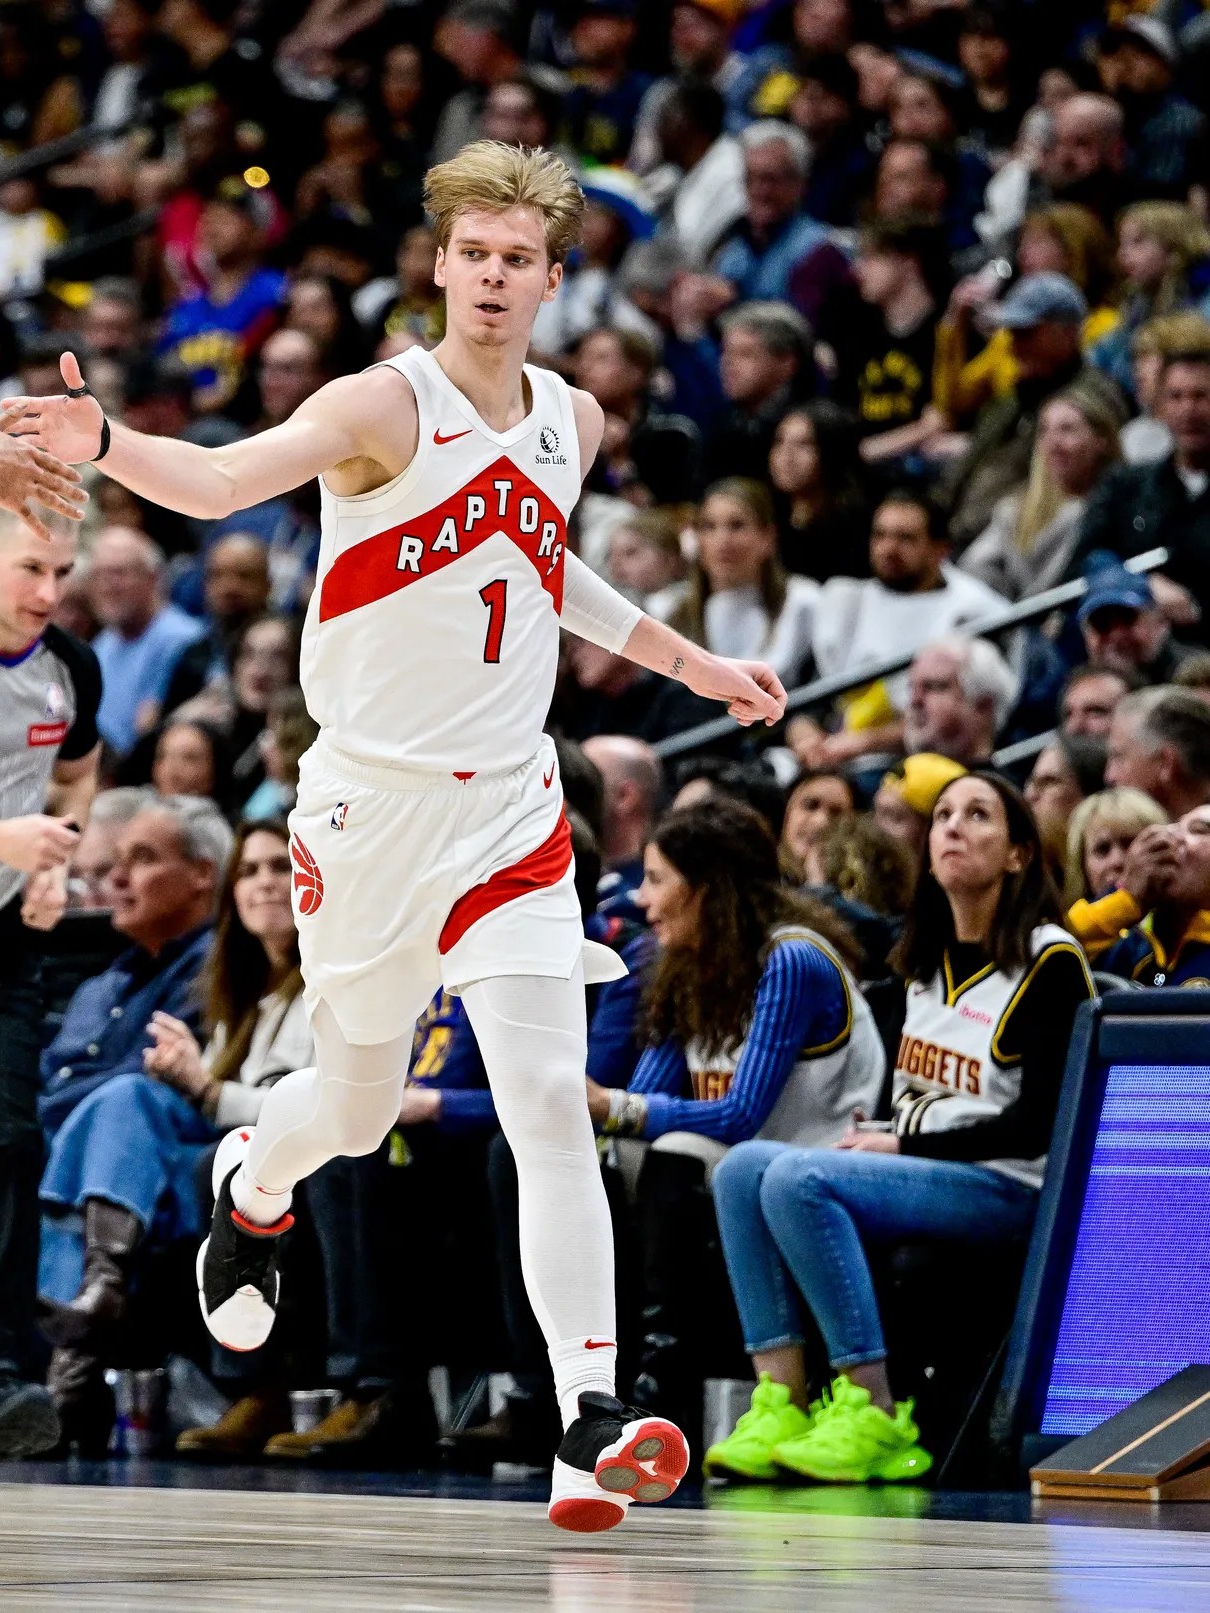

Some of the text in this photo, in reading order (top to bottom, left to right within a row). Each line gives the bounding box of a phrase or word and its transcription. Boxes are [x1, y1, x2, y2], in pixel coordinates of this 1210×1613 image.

[535, 454, 567, 465] Sun Life
[478, 579, 508, 664] 1
